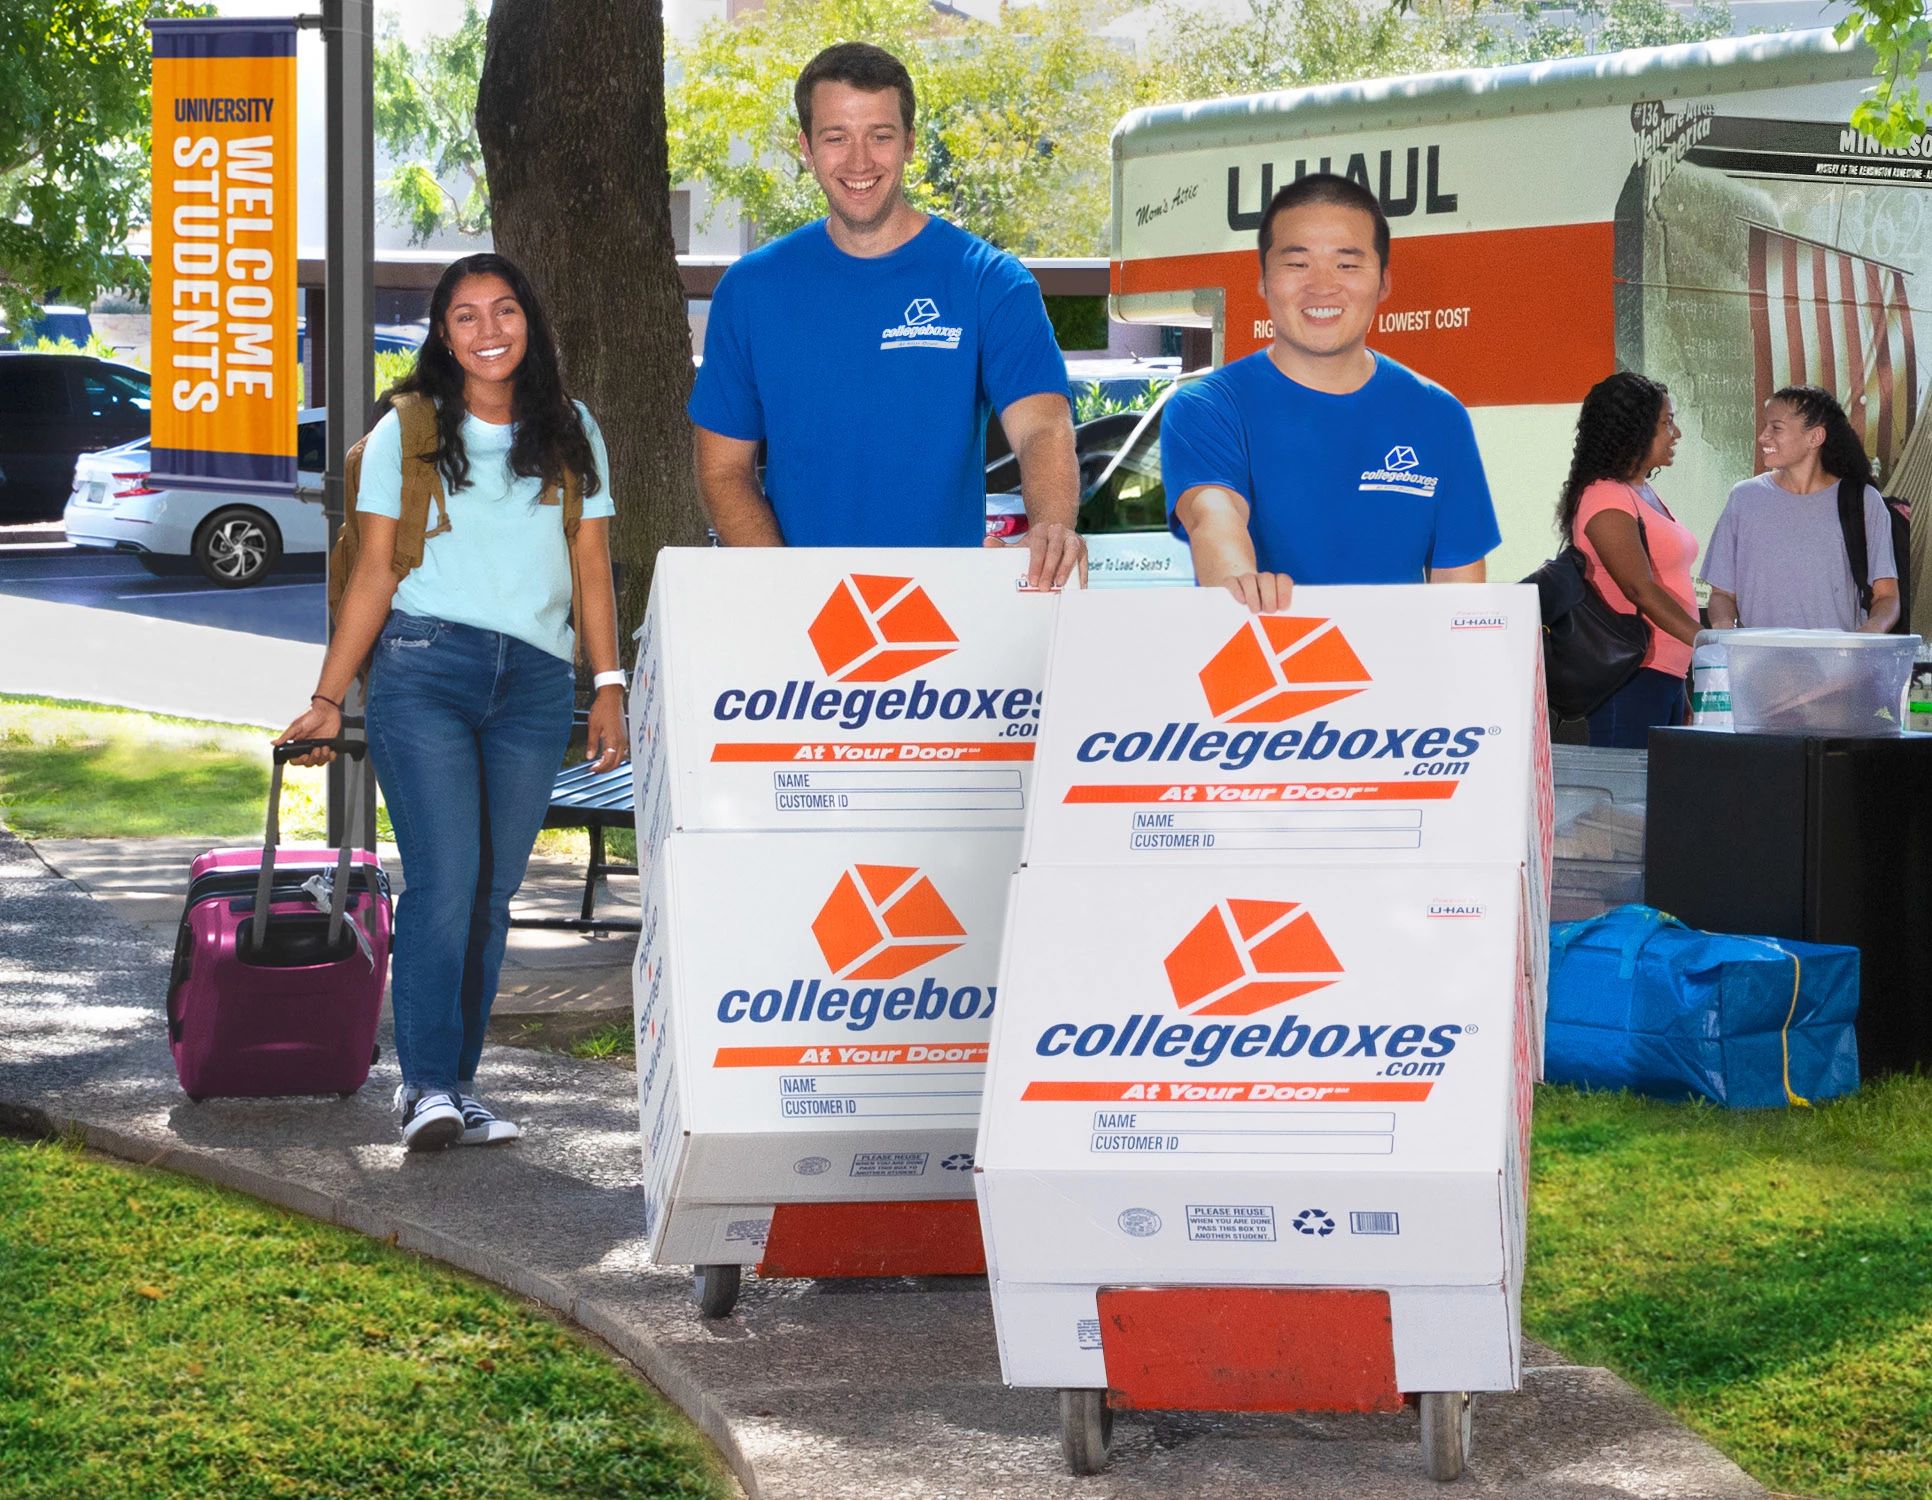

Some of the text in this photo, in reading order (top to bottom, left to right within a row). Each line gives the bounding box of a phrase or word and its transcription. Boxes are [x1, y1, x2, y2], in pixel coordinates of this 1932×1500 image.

[174, 97, 274, 123] UNIVERSITY
[1136, 184, 1199, 227] Mom's Attic
[173, 137, 219, 412] STUDENTS
[226, 136, 273, 398] WELCOME
[1378, 311, 1431, 333] LOWEST
[1435, 307, 1471, 329] COST
[1361, 469, 1438, 486] collegeboxes
[1454, 618, 1505, 626] U-HAUL
[792, 745, 824, 761] At
[833, 745, 893, 761] Your
[1403, 760, 1470, 776] .com
[777, 774, 810, 788] NAME
[779, 794, 848, 808] CUSTOMER ID
[1159, 786, 1197, 801] At
[1205, 785, 1277, 801] Your
[1137, 814, 1175, 828] NAME
[1135, 834, 1215, 848] CUSTOMER ID
[1430, 906, 1483, 914] U-HAUL
[799, 1048, 831, 1064] At
[838, 1047, 902, 1063] Your
[1376, 1061, 1445, 1076] .com
[783, 1078, 817, 1093] NAME
[1120, 1084, 1161, 1100] At
[1169, 1084, 1244, 1100] Your
[785, 1099, 857, 1115] CUSTOMER ID
[1098, 1113, 1137, 1128] NAME
[1095, 1135, 1179, 1150] CUSTOMER ID
[1194, 1207, 1266, 1216] PLEASE REUSE
